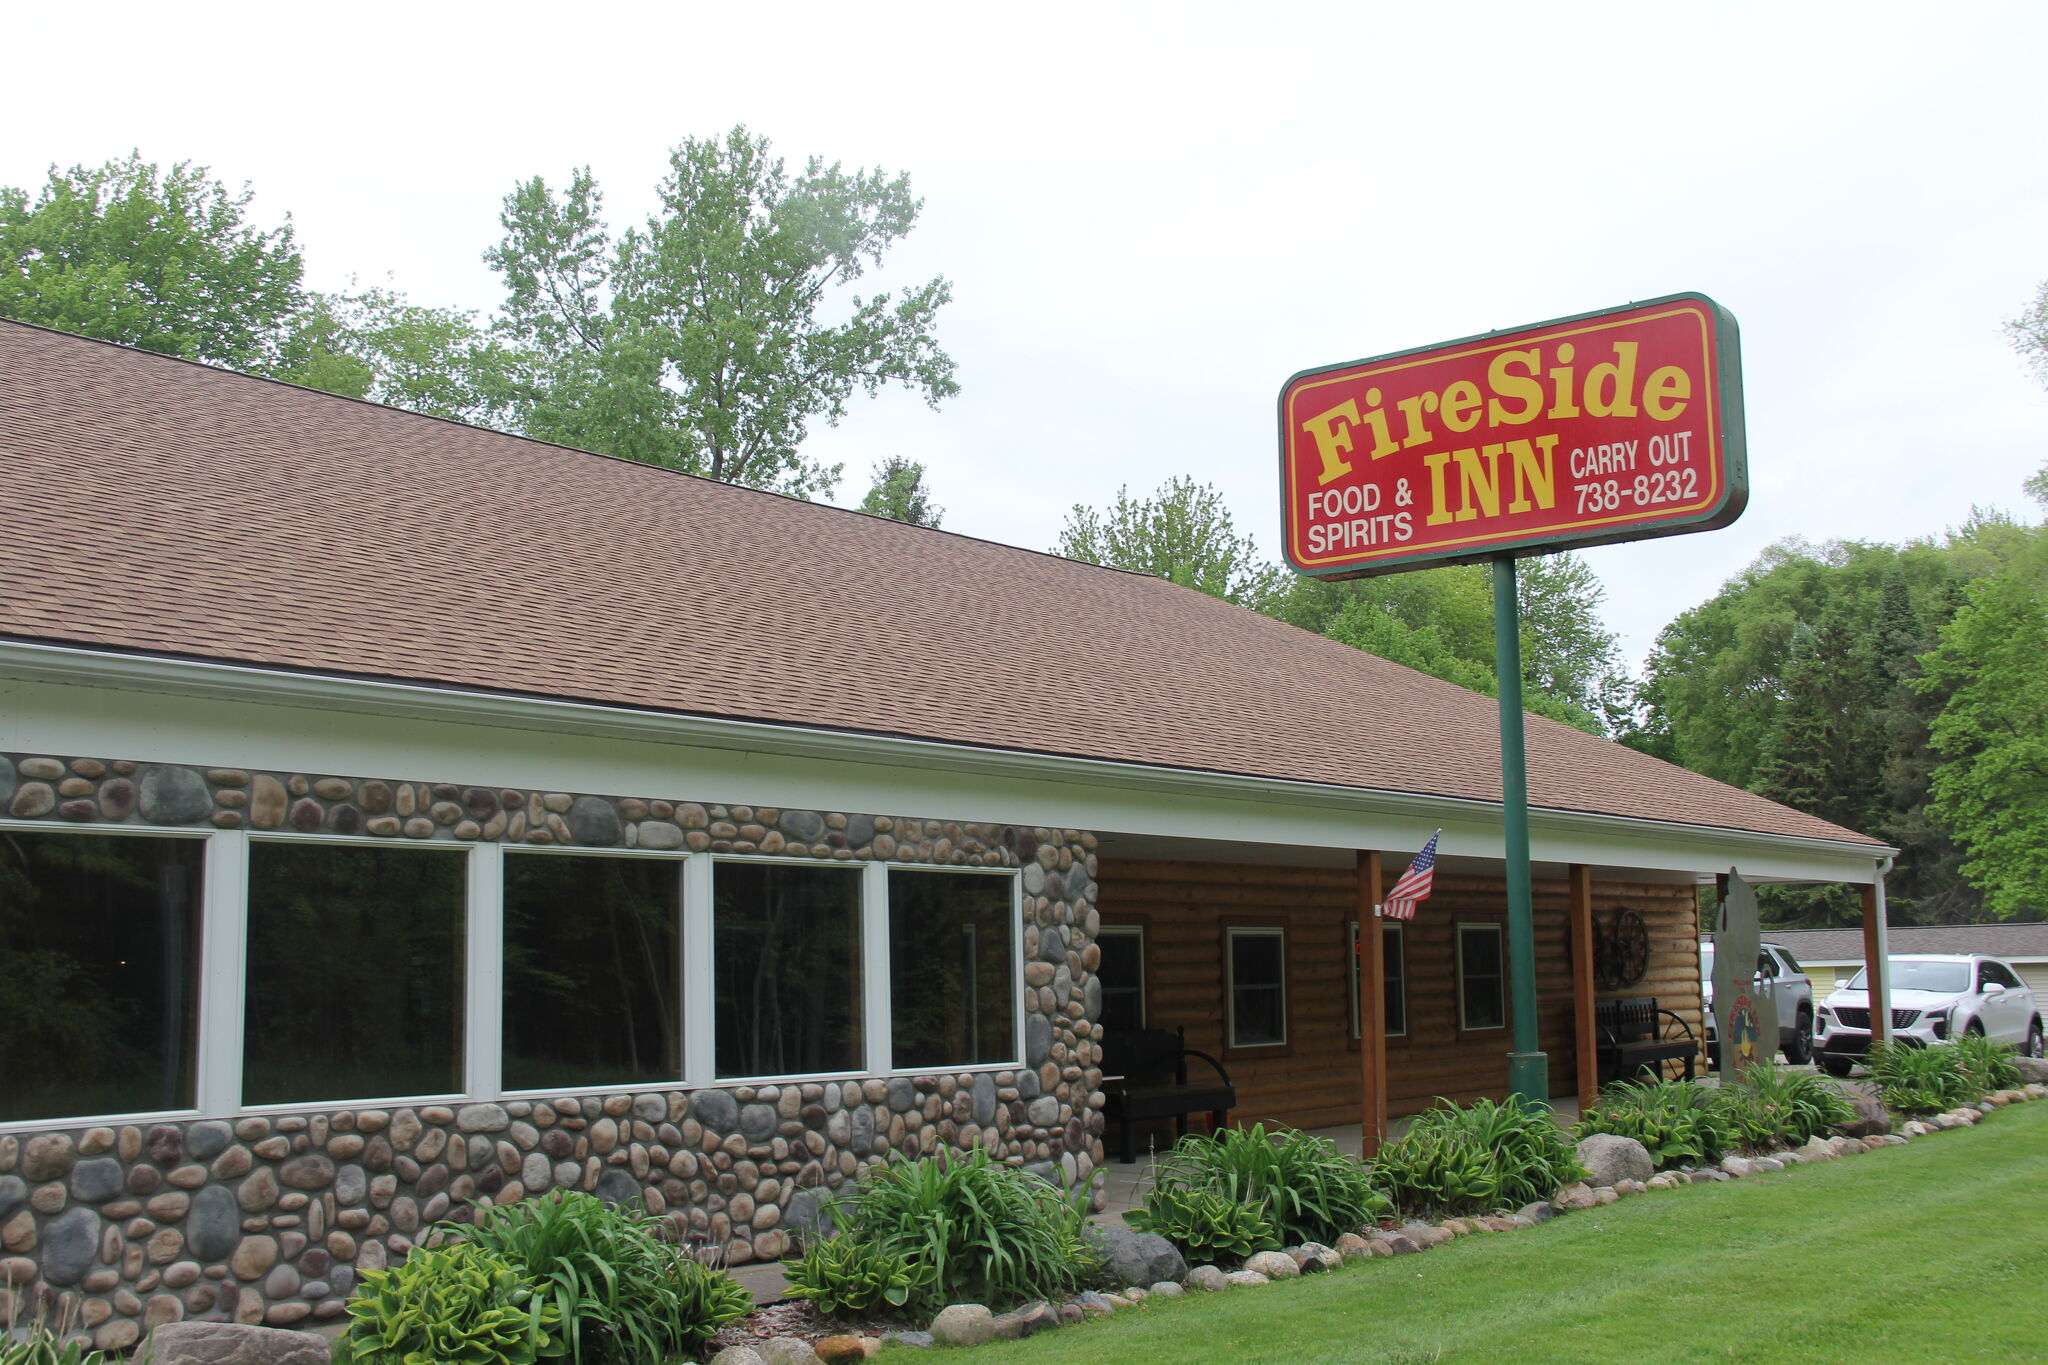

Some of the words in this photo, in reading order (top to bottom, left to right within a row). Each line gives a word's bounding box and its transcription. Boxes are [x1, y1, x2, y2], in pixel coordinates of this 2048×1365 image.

[1302, 341, 1691, 486] FireSide
[1570, 439, 1639, 479] CARRY
[1648, 431, 1692, 467] OUT
[1308, 483, 1381, 521] FOOD
[1394, 477, 1414, 507] &
[1423, 433, 1560, 526] INN
[1573, 467, 1698, 515] 738-8232
[1307, 511, 1413, 554] SPIRITS
